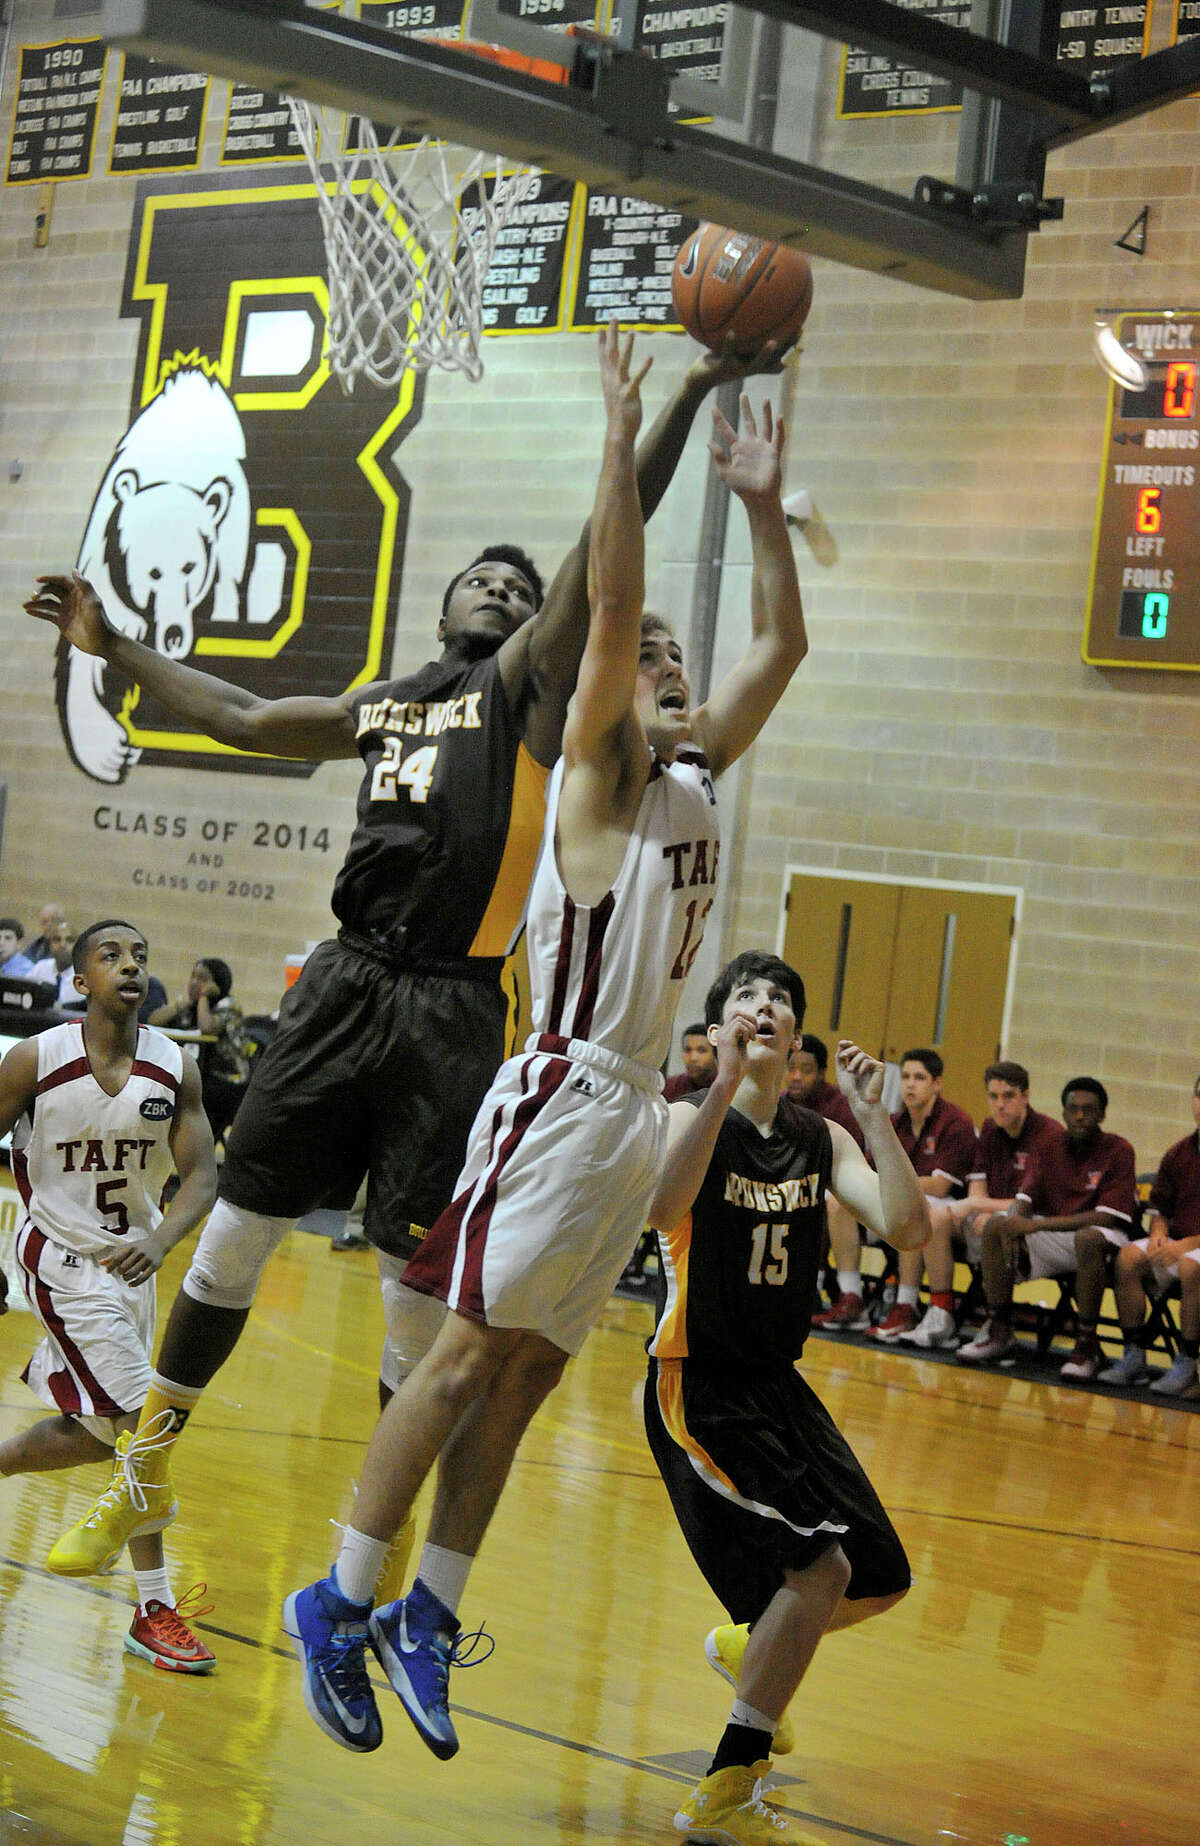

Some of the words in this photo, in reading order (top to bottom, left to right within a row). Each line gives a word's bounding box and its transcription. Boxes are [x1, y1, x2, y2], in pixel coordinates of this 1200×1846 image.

[385, 5, 436, 28] 1993
[643, 4, 728, 33] CHAMPIONS
[44, 49, 83, 70] 1990
[496, 201, 571, 226] CAMPIONS
[1135, 323, 1194, 350] WICK
[1163, 361, 1197, 418] 0
[1144, 429, 1200, 450] BONUS
[1114, 465, 1196, 486] TIMEOUTS
[1135, 487, 1162, 535] 6
[1126, 537, 1166, 557] LEFT
[1122, 568, 1175, 589] FOULS
[1141, 591, 1170, 640] 0
[370, 736, 438, 803] 24
[94, 806, 188, 838] CLASS
[201, 820, 238, 843] OF
[253, 821, 330, 852] 2014
[187, 852, 225, 868] AND
[132, 868, 189, 891] CLASS
[197, 879, 220, 893] OF
[227, 881, 275, 900] 2002
[143, 1102, 169, 1116] ZBK
[56, 1139, 156, 1173] TAFT
[96, 1177, 130, 1236] 5
[748, 1223, 790, 1286] 15
